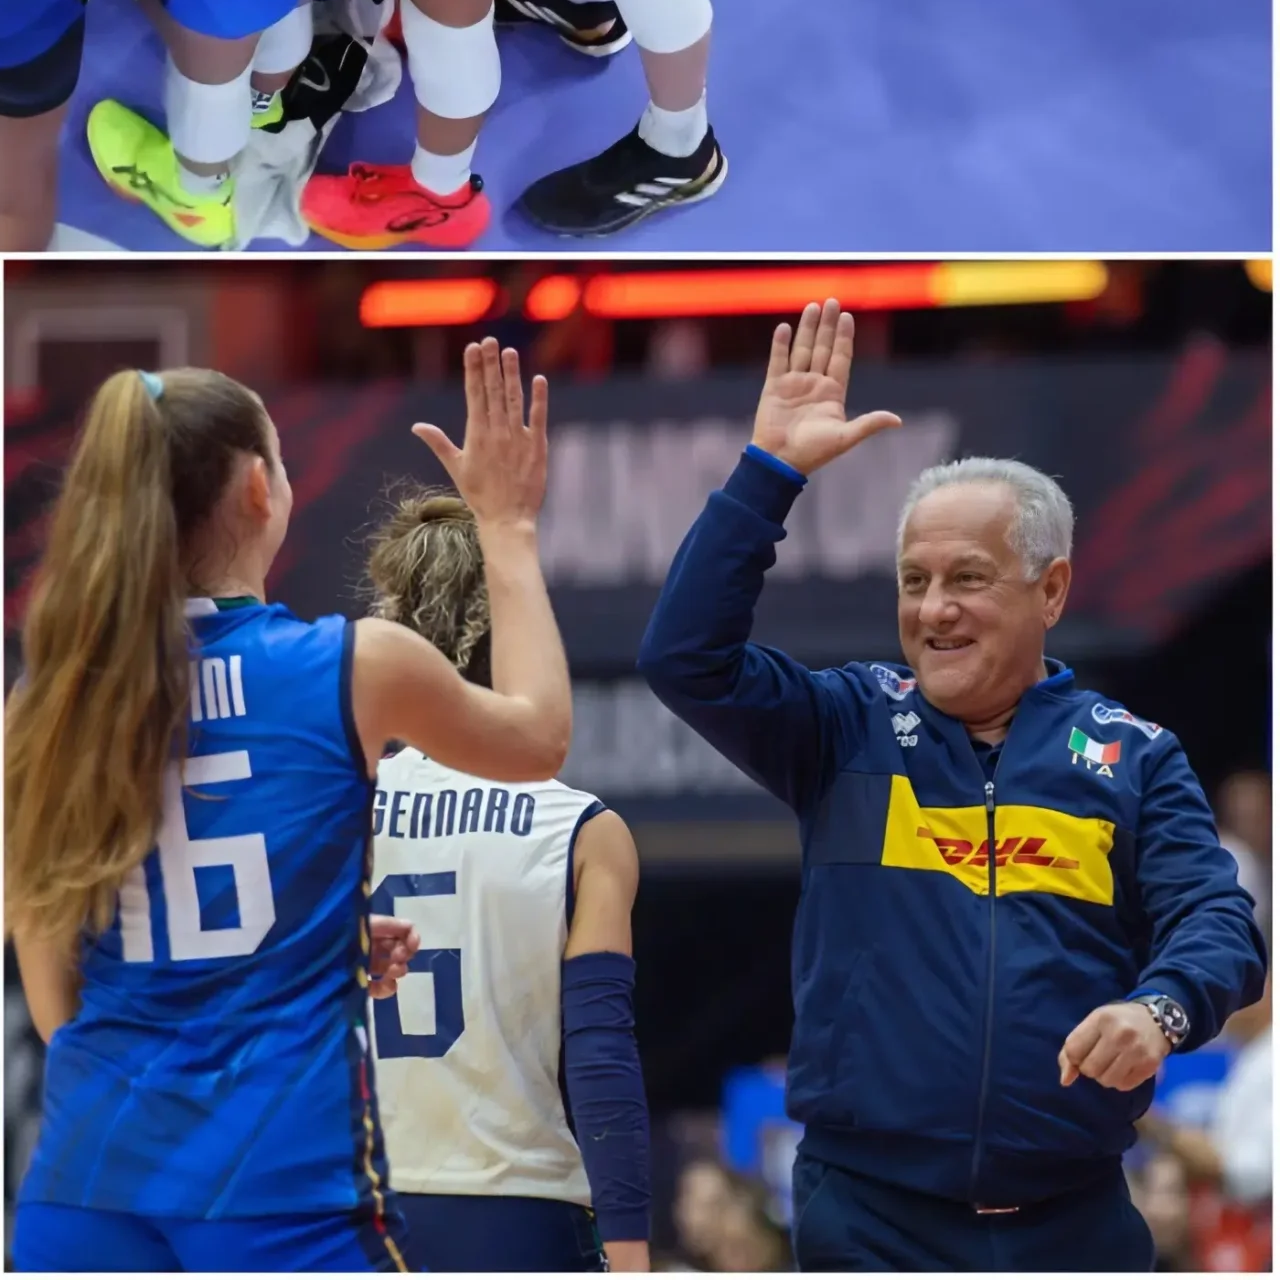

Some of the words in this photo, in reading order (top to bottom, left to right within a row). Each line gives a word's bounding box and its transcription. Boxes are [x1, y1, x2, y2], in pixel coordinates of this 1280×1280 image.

[1071, 752, 1115, 778] ITA
[372, 787, 536, 840] GENNARO
[927, 834, 1062, 869] DHL
[371, 870, 466, 1060] 6
